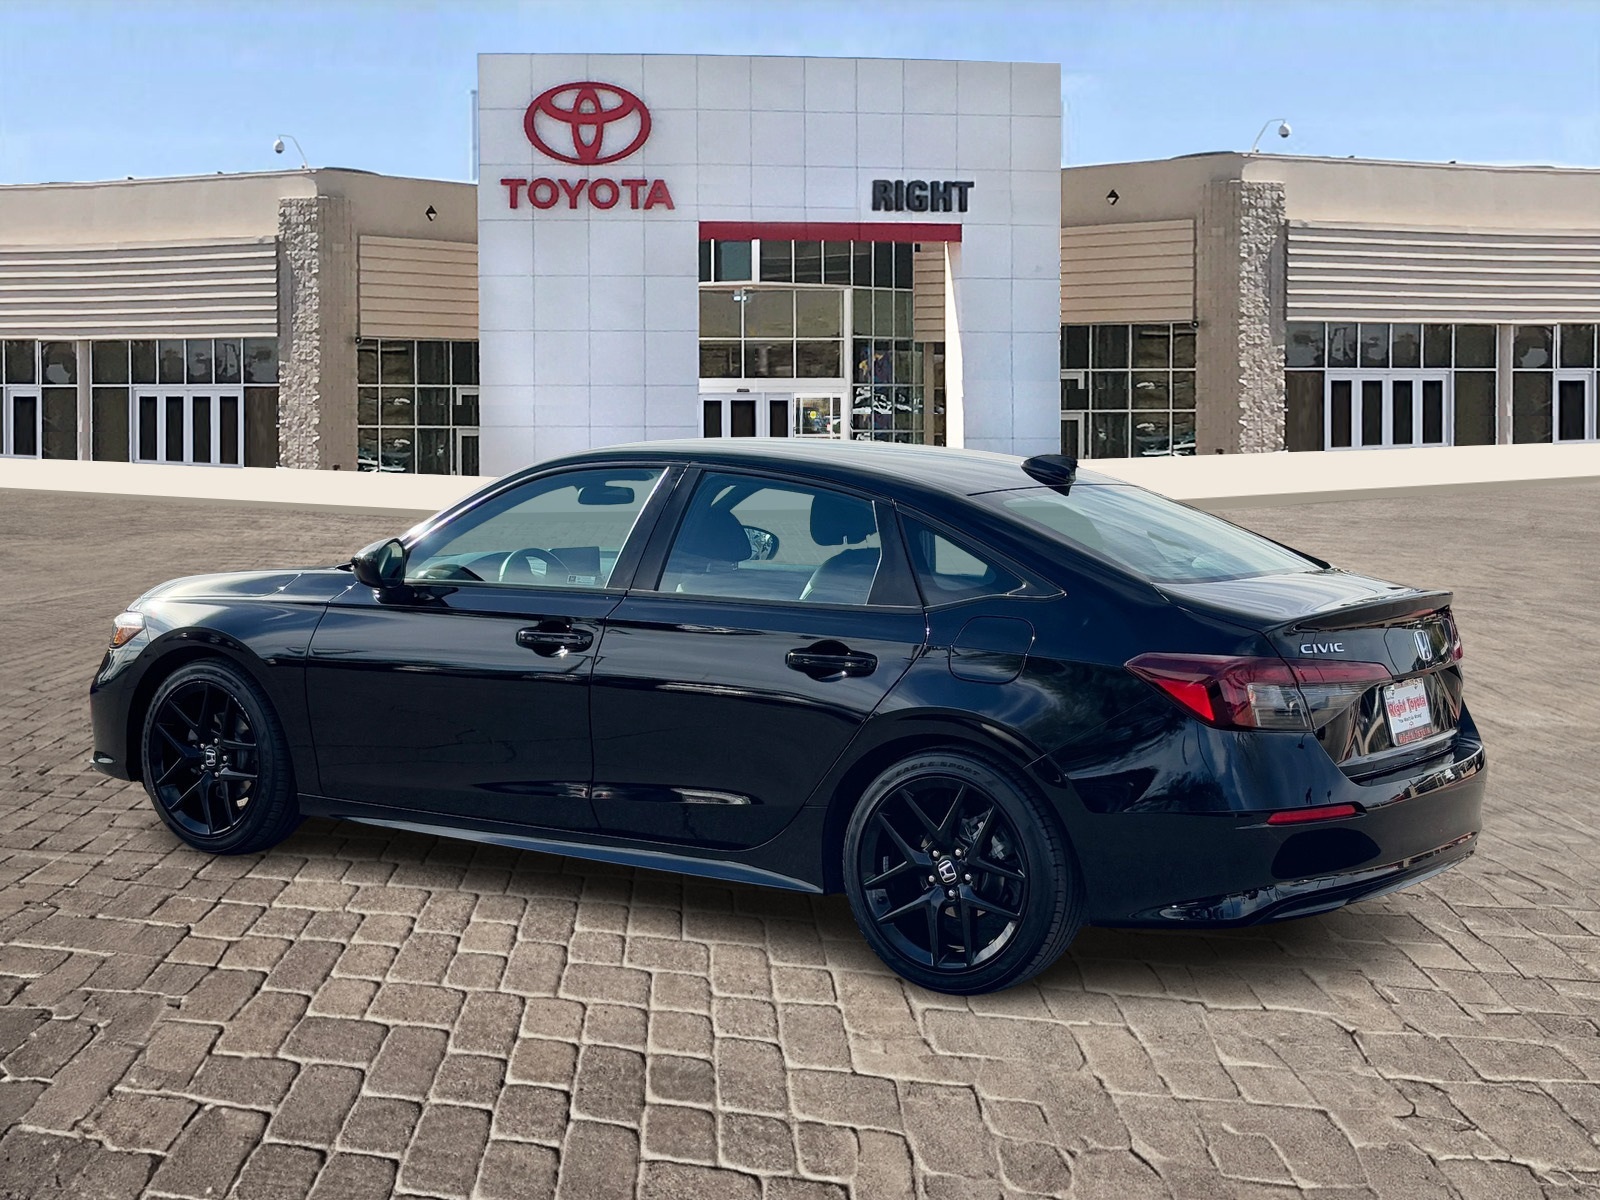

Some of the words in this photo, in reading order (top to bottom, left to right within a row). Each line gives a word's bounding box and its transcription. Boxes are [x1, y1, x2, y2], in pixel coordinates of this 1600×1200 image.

[500, 178, 675, 209] TOYOTA
[872, 180, 975, 212] RIGHT
[1300, 642, 1345, 654] CIVIC
